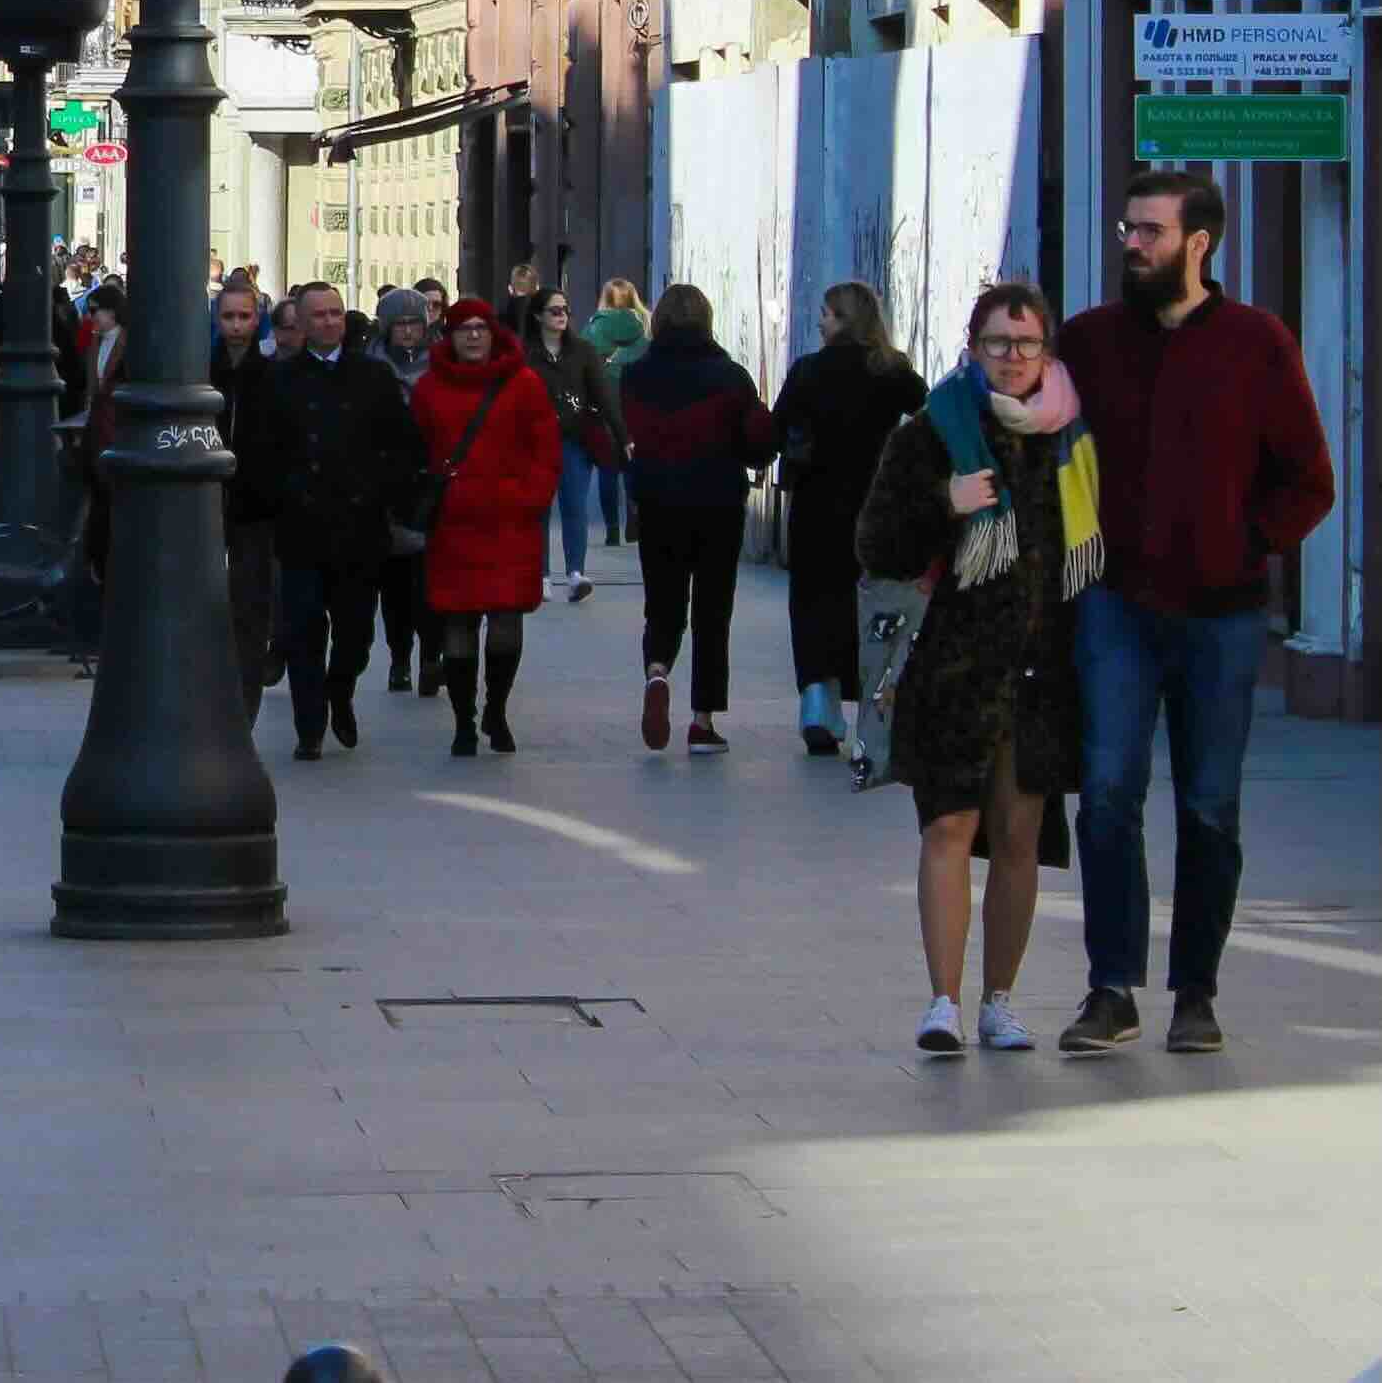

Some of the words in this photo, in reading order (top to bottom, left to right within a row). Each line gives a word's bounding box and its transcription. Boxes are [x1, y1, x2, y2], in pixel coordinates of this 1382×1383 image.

[1182, 28, 1226, 43] HMD
[1231, 27, 1328, 43] PERSONAL
[1253, 53, 1286, 62] PRACA
[1288, 53, 1298, 62] W
[1299, 53, 1339, 62] POLSCE
